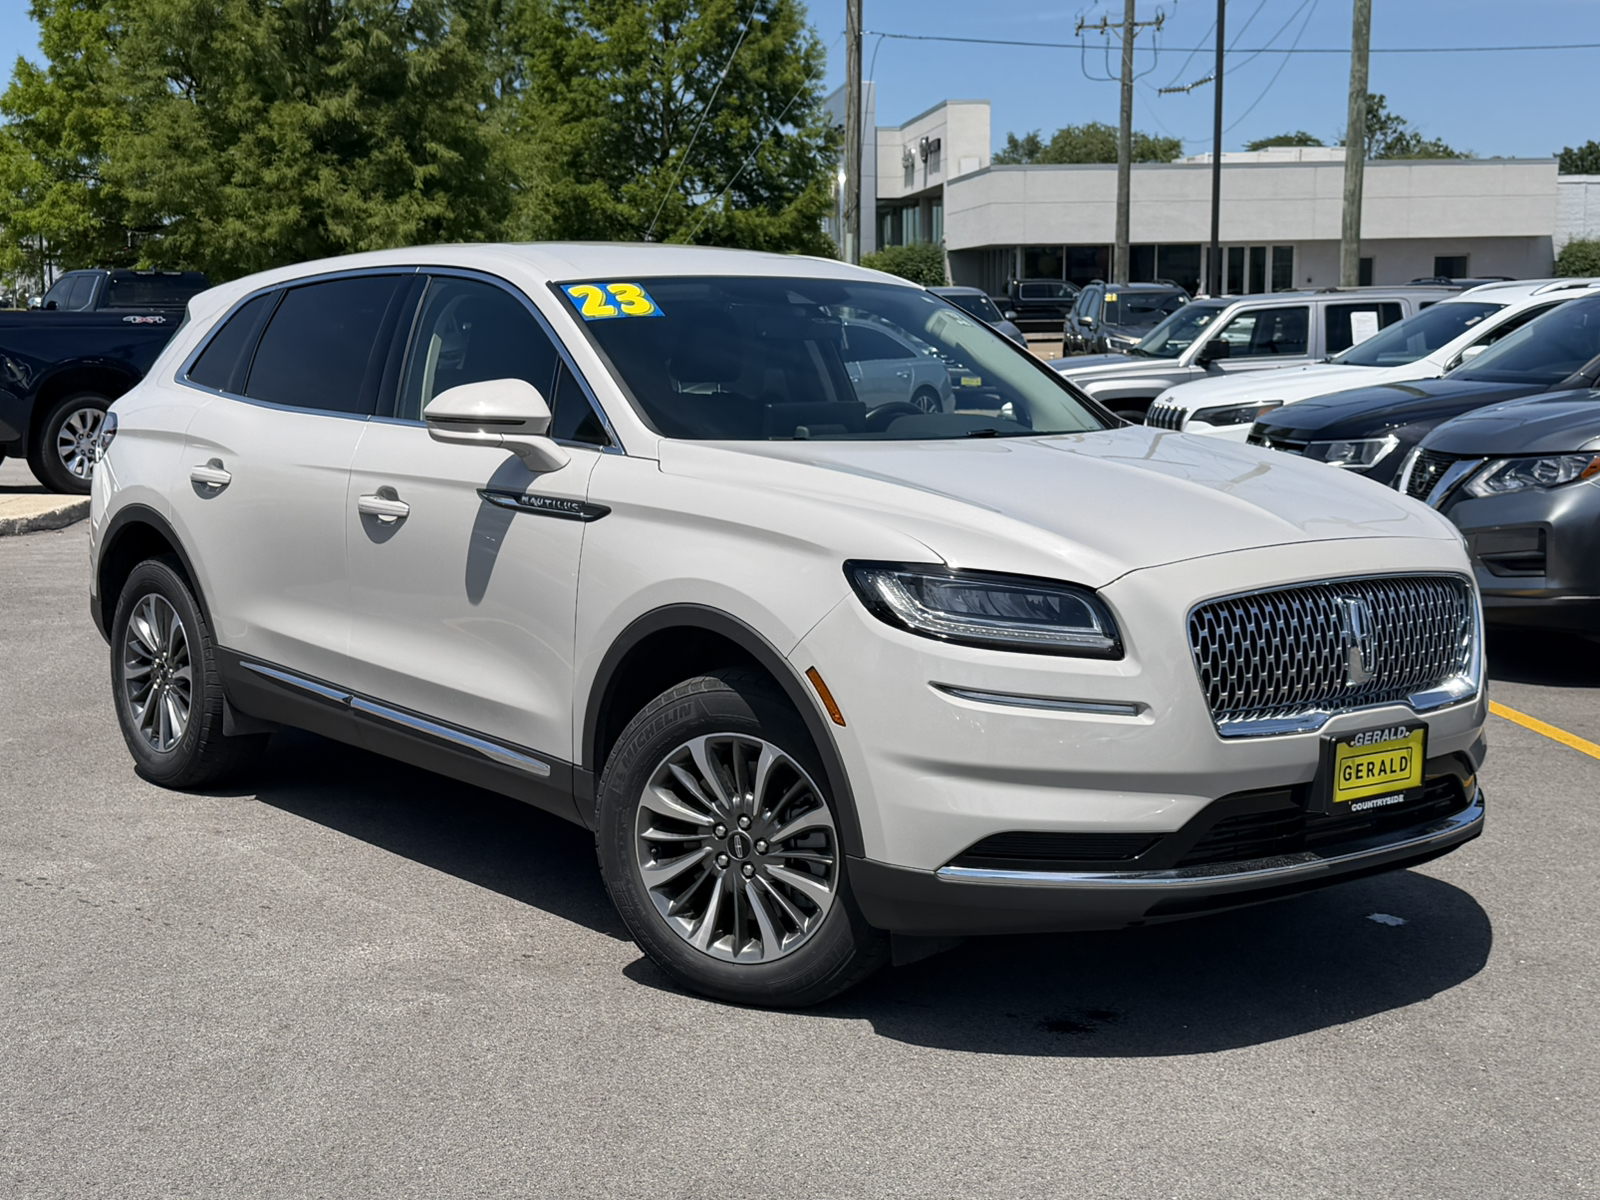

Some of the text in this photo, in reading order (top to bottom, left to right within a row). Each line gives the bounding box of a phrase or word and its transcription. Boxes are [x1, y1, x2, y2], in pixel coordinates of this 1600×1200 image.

[568, 284, 655, 316] 23
[521, 496, 579, 512] NAUTILUS
[621, 703, 692, 769] MICHELIN
[1355, 726, 1406, 746] GERALD
[1343, 756, 1408, 782] GERALD
[1351, 794, 1404, 812] COUNTRYSIDE
